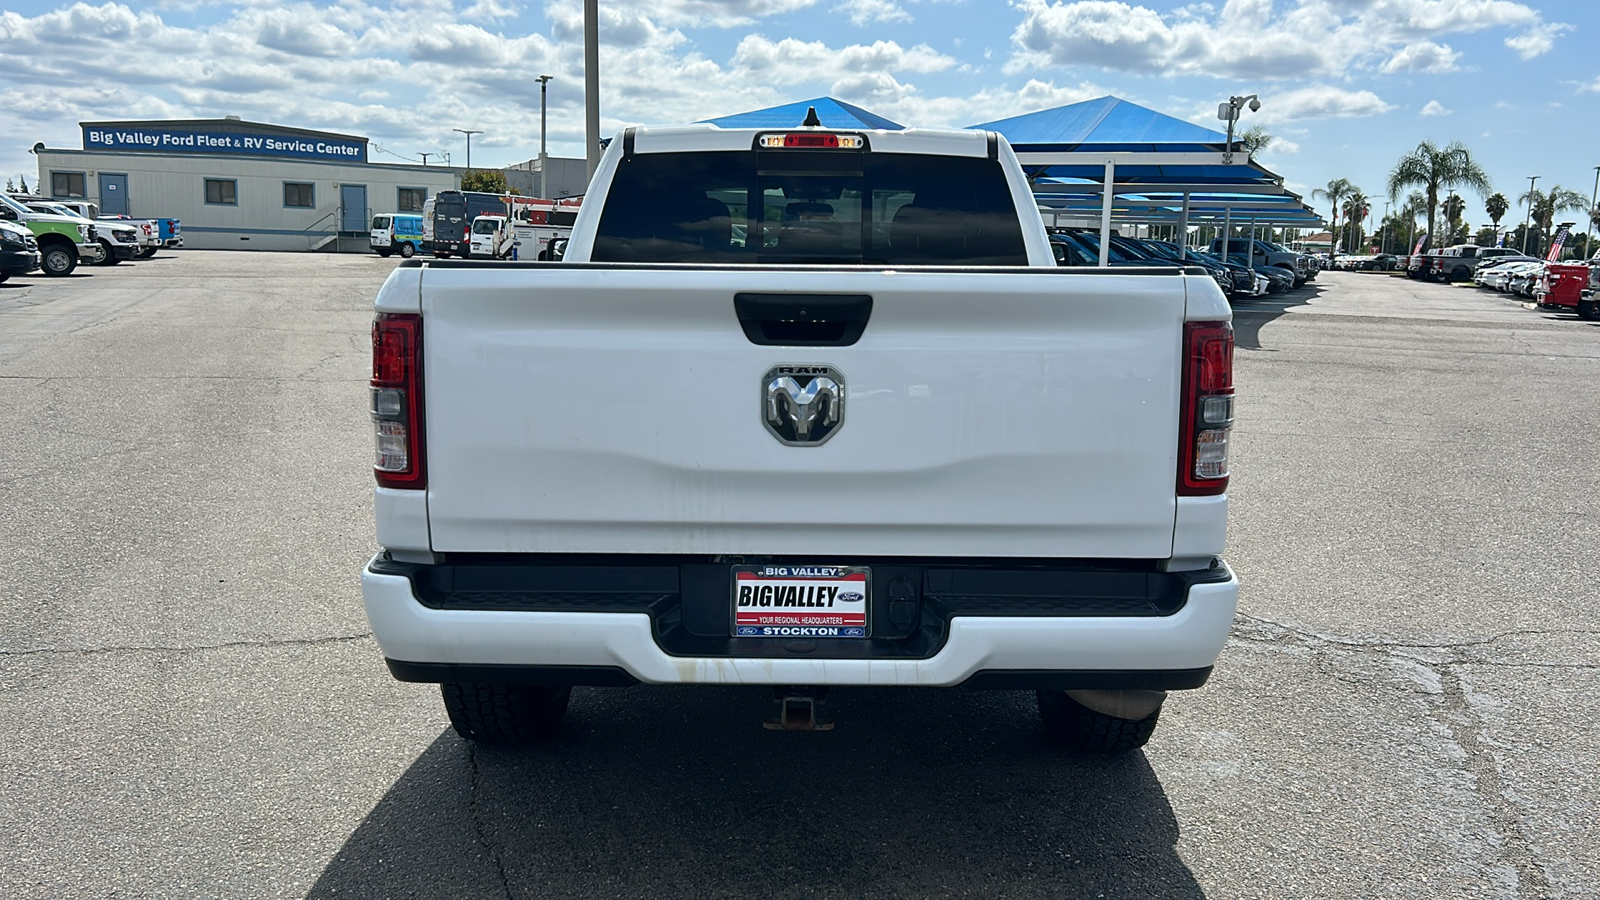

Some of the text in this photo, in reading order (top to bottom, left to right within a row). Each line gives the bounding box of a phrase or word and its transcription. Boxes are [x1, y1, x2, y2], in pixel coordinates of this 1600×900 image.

[89, 131, 360, 156] Big Valley Ford Fleet & RV Service Center
[765, 567, 837, 576] BIG VALLEY
[841, 592, 860, 601] Ford
[759, 616, 843, 625] YOUR REGIONAL HEADQUARTERS
[763, 627, 838, 635] STOCKTON
